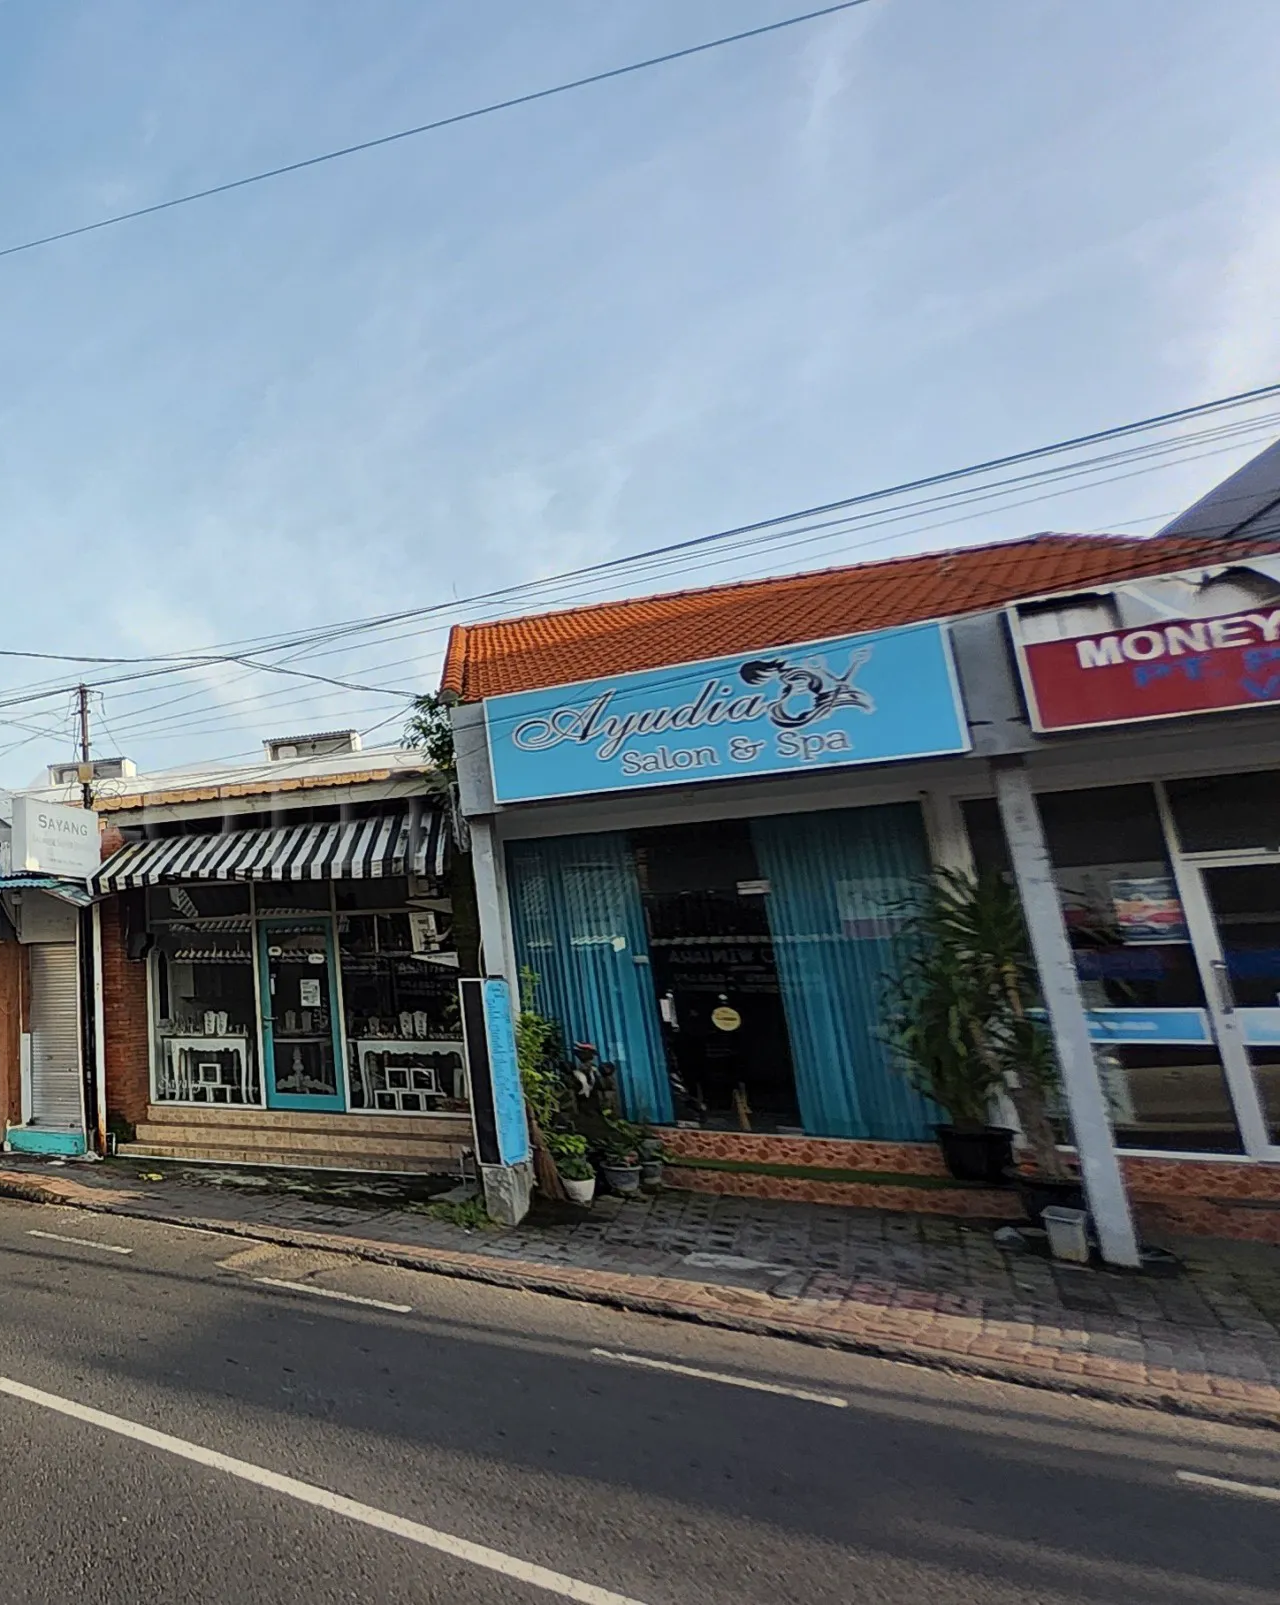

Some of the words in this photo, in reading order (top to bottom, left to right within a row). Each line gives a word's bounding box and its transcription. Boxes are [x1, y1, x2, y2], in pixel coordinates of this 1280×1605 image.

[1075, 608, 1280, 669] MONEY
[513, 678, 768, 760] Ayudia
[622, 744, 718, 776] Salon
[728, 737, 764, 761] &
[776, 729, 850, 761] Spa
